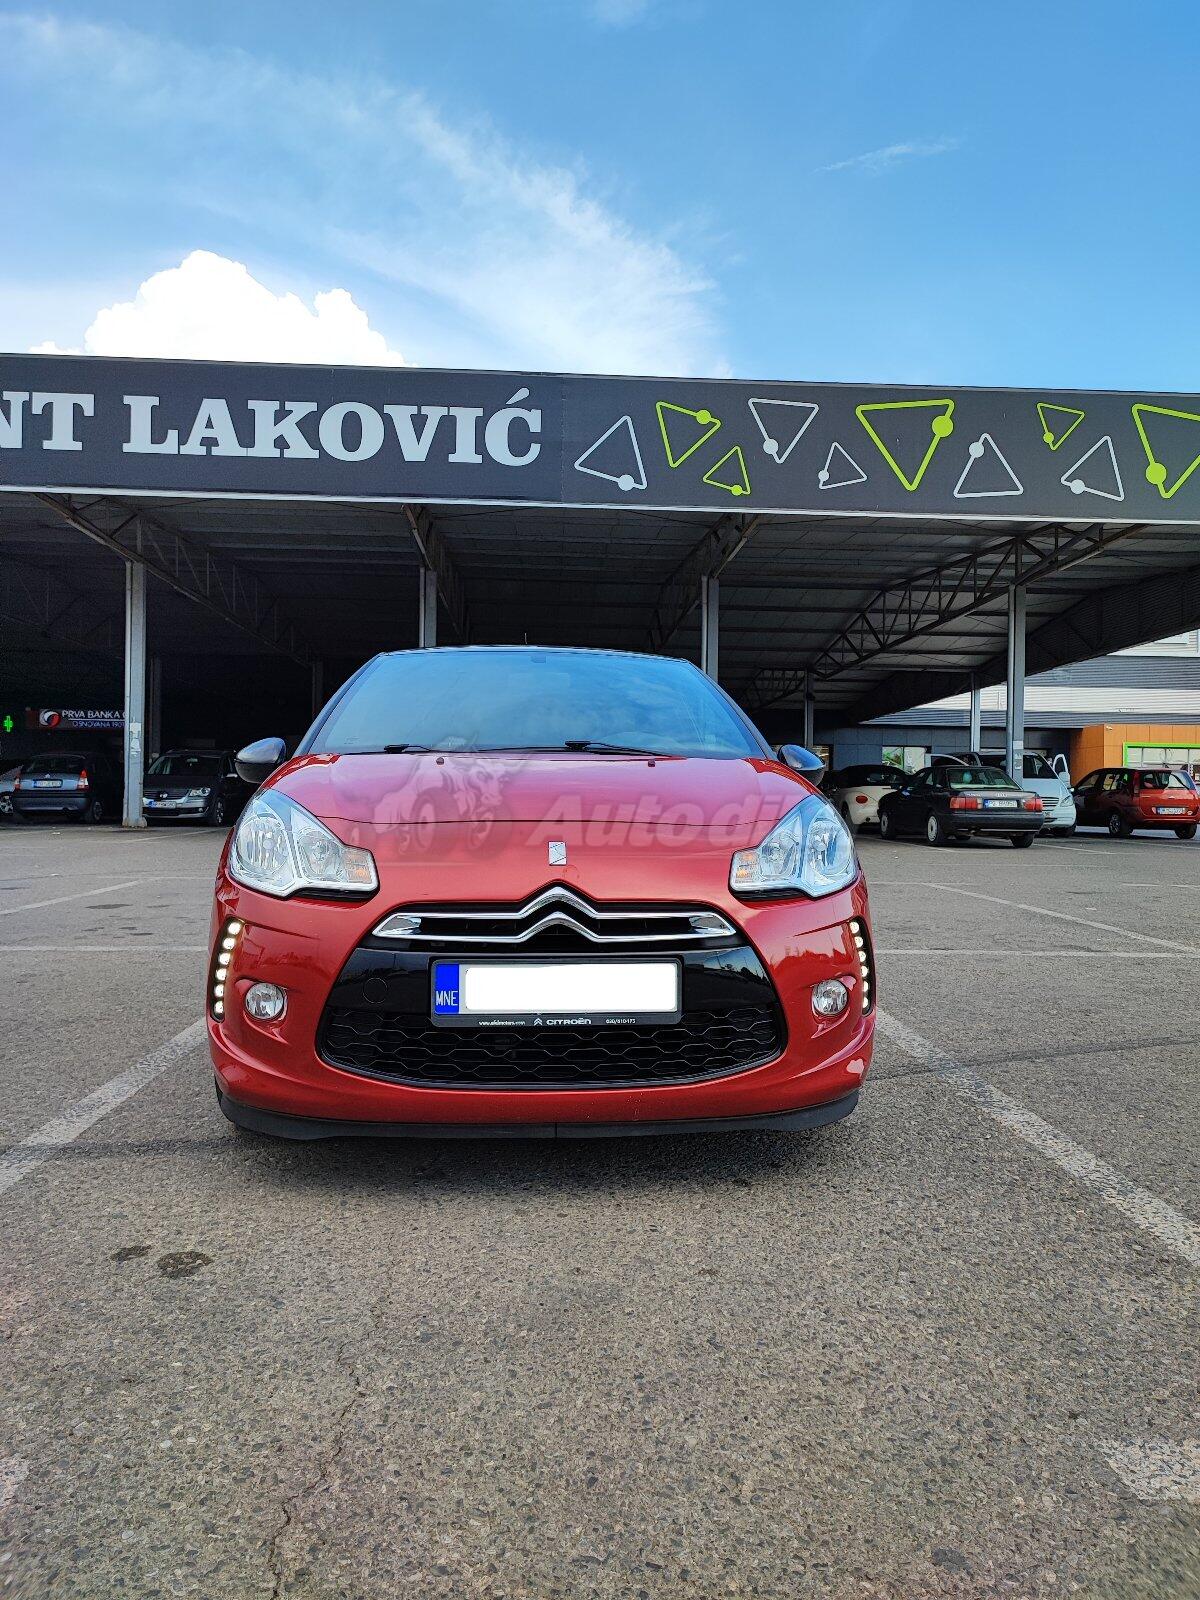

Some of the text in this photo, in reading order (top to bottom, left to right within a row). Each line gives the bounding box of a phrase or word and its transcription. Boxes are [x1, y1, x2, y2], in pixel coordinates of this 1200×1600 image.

[122, 387, 542, 467] LAKOVIĆ
[62, 710, 85, 718] PRVA
[88, 710, 120, 719] BANKA
[435, 990, 459, 1006] MNE
[546, 1018, 592, 1026] CITROËN
